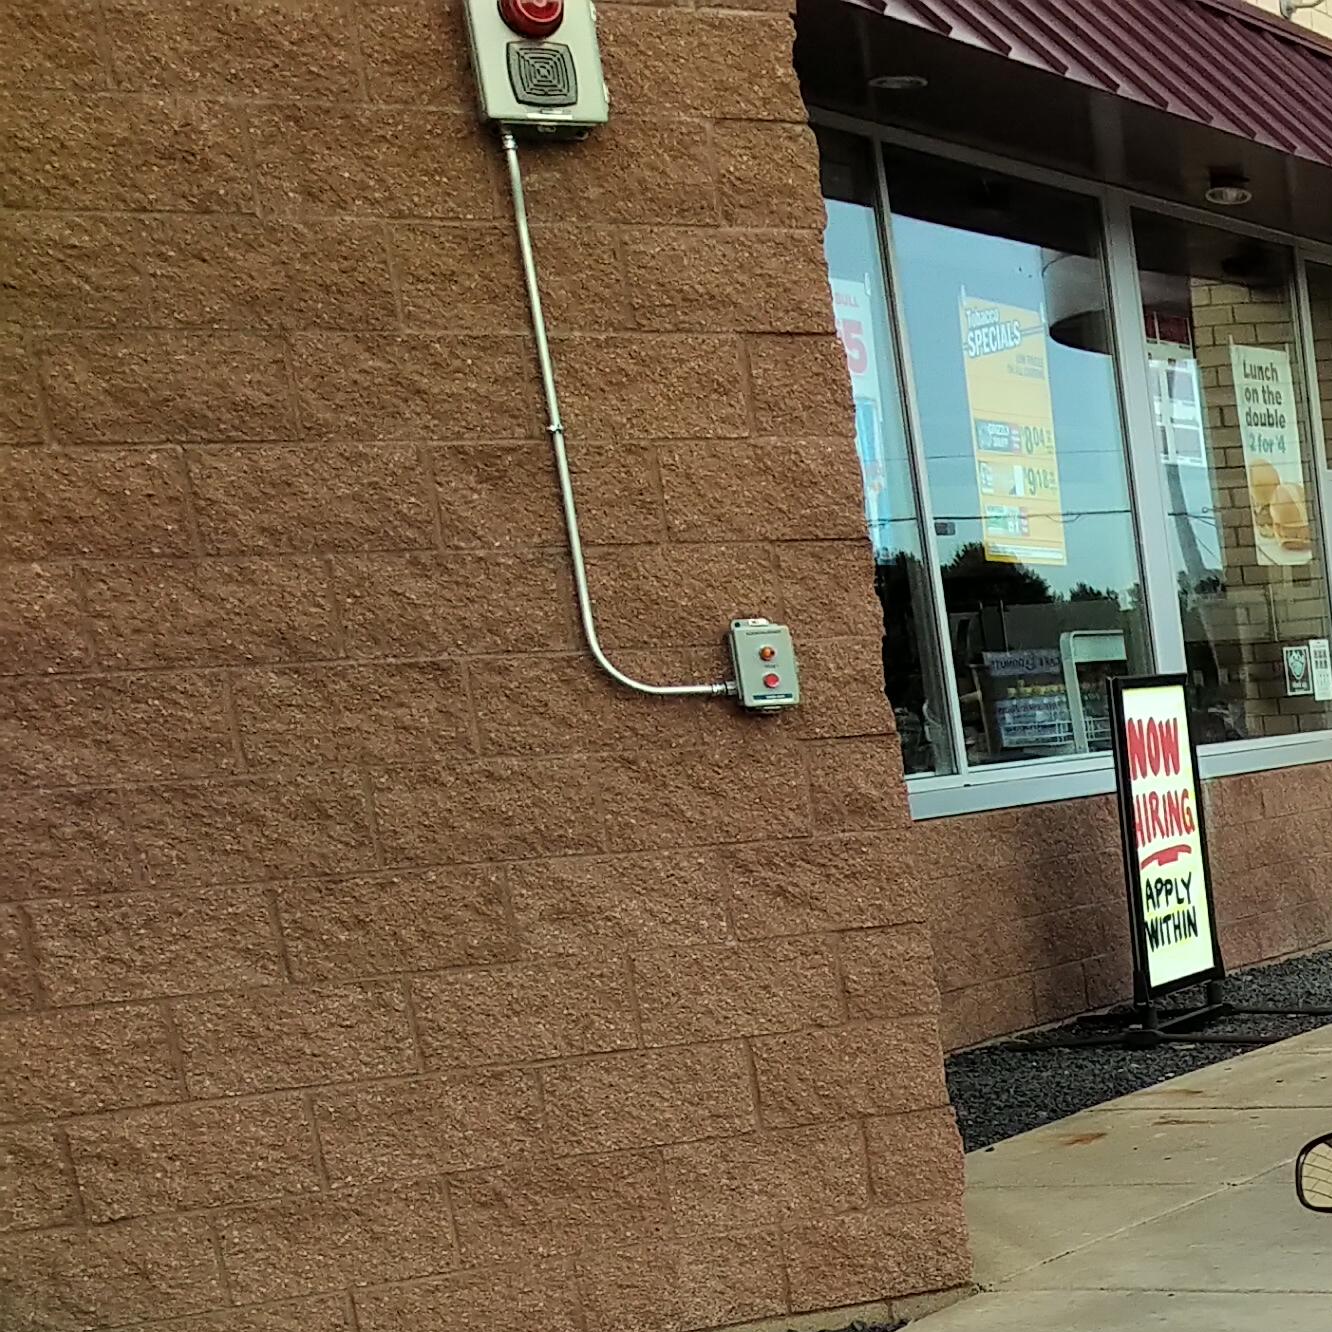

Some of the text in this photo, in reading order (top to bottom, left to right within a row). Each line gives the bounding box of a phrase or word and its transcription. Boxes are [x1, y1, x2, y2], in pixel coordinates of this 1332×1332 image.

[966, 309, 999, 328] Tobacco
[967, 320, 1021, 357] SPECIALS
[1242, 359, 1279, 383] Lunch
[1244, 386, 1282, 405] on the
[1245, 408, 1286, 428] double
[1249, 432, 1257, 452] 2
[1258, 433, 1274, 453] for
[1126, 716, 1180, 781] NOW
[1132, 788, 1196, 849] HIRING
[1145, 871, 1193, 912] APPLY
[1144, 905, 1199, 952] WITHIN
